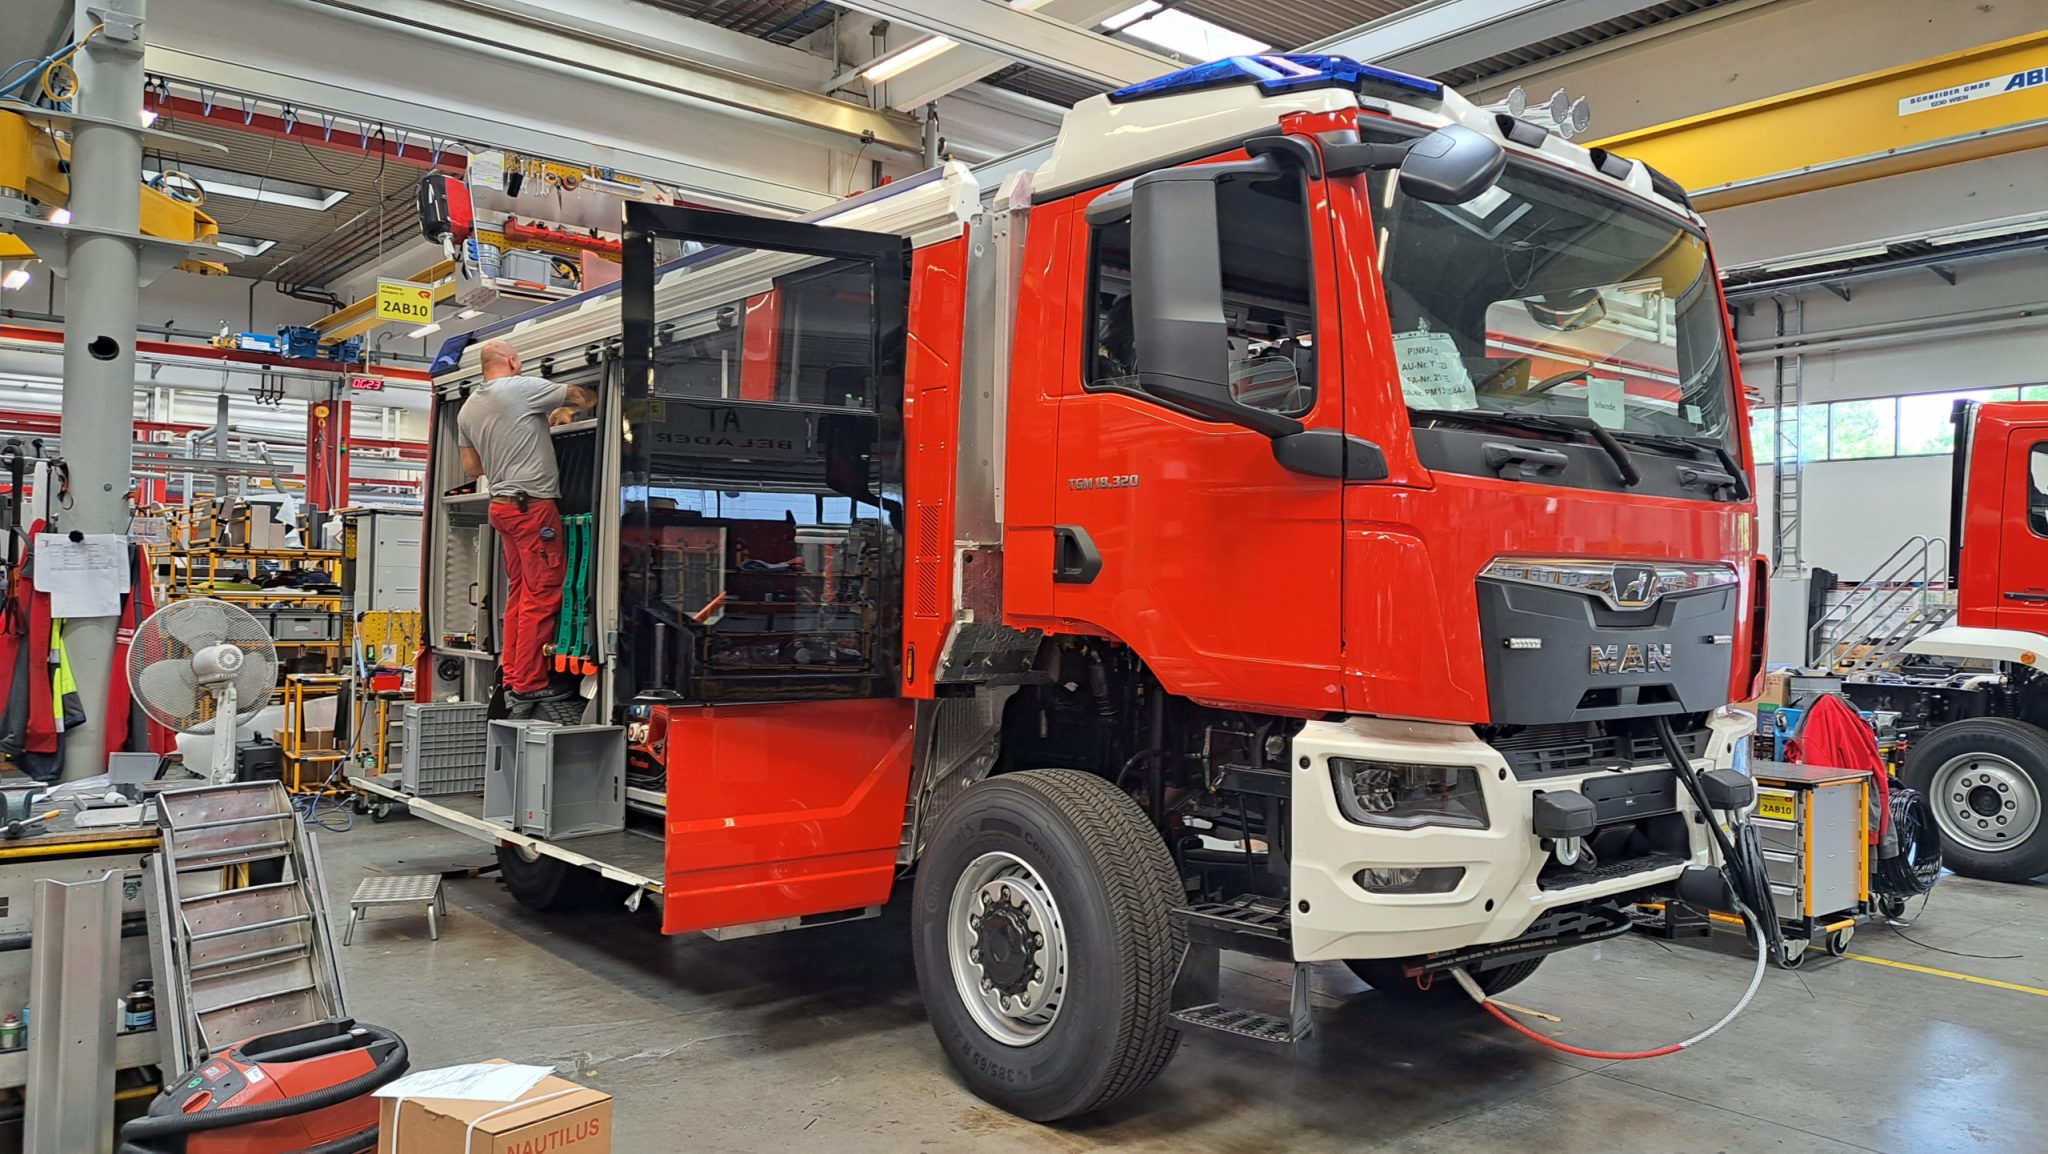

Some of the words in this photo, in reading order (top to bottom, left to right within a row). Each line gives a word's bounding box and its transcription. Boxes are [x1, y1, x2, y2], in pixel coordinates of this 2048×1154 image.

[2004, 67, 2048, 91] AB
[383, 300, 428, 317] 2AB10
[1094, 474, 1141, 489] 18.320
[1589, 643, 1672, 676] MAN
[1762, 804, 1792, 815] 2AB10
[506, 1117, 600, 1154] NAUTILUS
